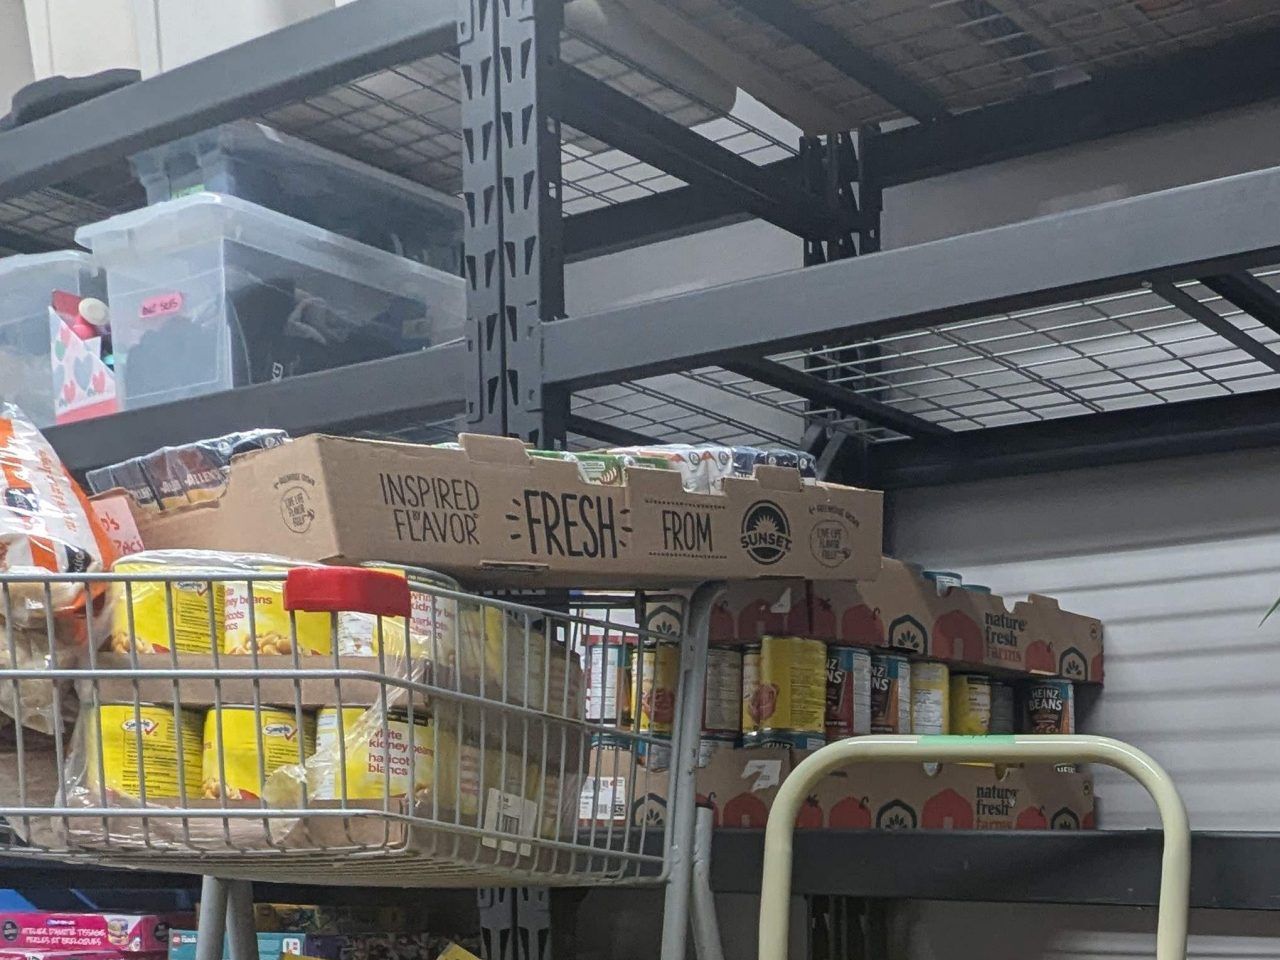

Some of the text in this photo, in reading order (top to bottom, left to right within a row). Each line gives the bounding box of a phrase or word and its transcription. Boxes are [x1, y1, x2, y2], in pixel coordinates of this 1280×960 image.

[379, 473, 480, 511] INSPIRED
[524, 490, 618, 559] FRESH
[661, 510, 714, 553] FROM
[740, 531, 793, 552] SUNSET
[984, 610, 1026, 632] nature
[984, 627, 1019, 648] fresh
[1031, 687, 1061, 701] HEINZ
[1028, 698, 1063, 712] BEANS
[976, 784, 1018, 799] nature
[976, 798, 1011, 816] fresh
